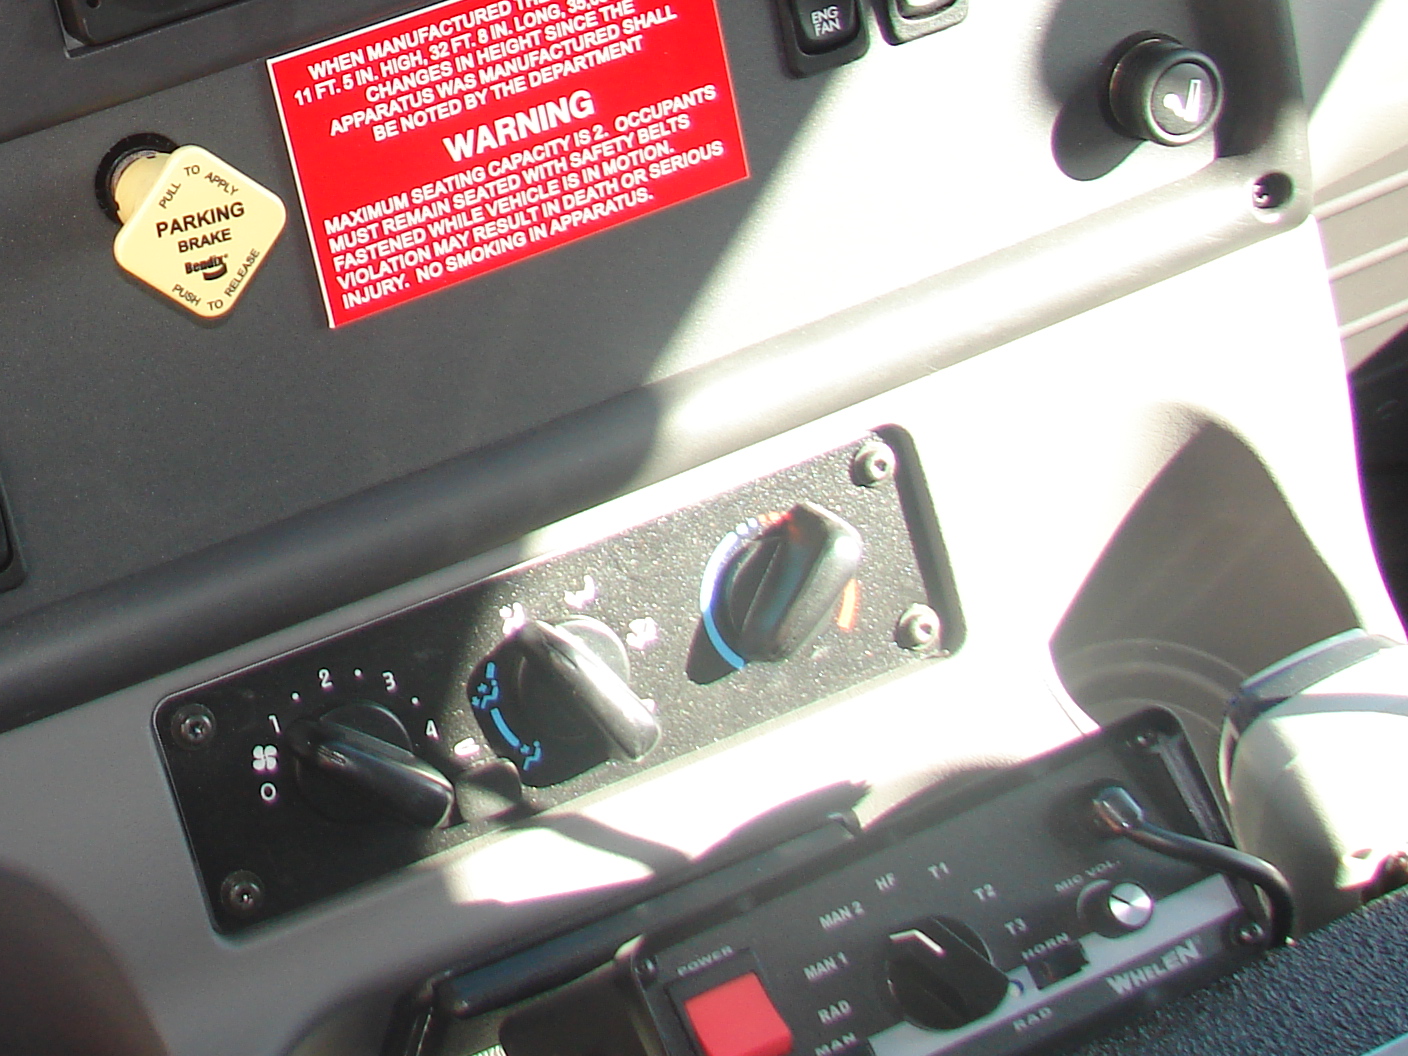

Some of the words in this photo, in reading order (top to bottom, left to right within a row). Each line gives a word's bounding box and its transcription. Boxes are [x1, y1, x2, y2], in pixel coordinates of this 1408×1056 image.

[811, 6, 839, 25] ENG
[814, 19, 841, 37] FAN
[294, 89, 313, 106] 11
[314, 79, 342, 100] FT.
[342, 74, 354, 90] 5
[355, 66, 379, 86] IN.
[380, 52, 429, 78] HIGH,
[429, 42, 450, 61] 32
[450, 32, 477, 54] FT.
[477, 28, 489, 44] 8
[489, 20, 513, 40] IN.
[514, 4, 566, 32] LONG,
[307, 48, 365, 80] WHEN
[367, 0, 512, 61] MANUFACTURED
[365, 62, 452, 102] CHANGES
[455, 53, 475, 72] IN
[476, 29, 542, 65] HEIGHT
[545, 11, 598, 41] SINCE
[330, 87, 435, 136] APPARATUS
[436, 73, 477, 99] WAS
[479, 24, 620, 85] MANUFACTURED
[622, 5, 678, 34] SHALL
[372, 122, 399, 142] BE
[401, 98, 462, 133] NOTED
[465, 88, 489, 110] BY
[491, 76, 528, 100] THE
[528, 35, 643, 89] DEPARTMENT
[442, 89, 595, 162] WARNING
[324, 192, 410, 235] MAXIMUM
[410, 165, 486, 204] SEATING
[487, 135, 571, 177] CAPACITY
[574, 129, 591, 147] IS
[592, 124, 610, 141] 2.
[614, 84, 716, 132] OCCUPANTS
[159, 181, 181, 210] PULL
[184, 164, 201, 177] TO
[204, 171, 239, 197] APPLY
[328, 222, 379, 254] MUST
[381, 197, 451, 236] REMAIN
[452, 174, 521, 209] SEATED
[522, 156, 568, 185] WITH
[570, 131, 635, 168] SAFETY
[637, 113, 691, 143] BELTS
[333, 228, 427, 272] FASTENED
[428, 206, 486, 238] WHILE
[485, 179, 561, 217] VEHICLE
[562, 173, 580, 191] IS
[582, 166, 601, 184] IN
[602, 140, 675, 178] MOTION.
[156, 201, 245, 238] PARKING
[336, 248, 432, 290] VIOLATION
[433, 230, 471, 257] MAY
[473, 206, 539, 243] RESULT
[542, 198, 561, 218] IN
[562, 178, 619, 211] DEATH
[621, 168, 648, 188] OR
[649, 140, 724, 179] SERIOUS
[178, 228, 232, 253] BRAKE
[342, 273, 411, 310] INJURY.
[415, 261, 443, 283] NO
[445, 232, 527, 273] SMOKING
[529, 222, 547, 243] IN
[549, 187, 655, 236] APPARATUS.
[172, 283, 202, 307] PUSH
[207, 299, 224, 311] TO
[224, 248, 260, 297] RELEASE
[268, 714, 281, 734] 1
[318, 668, 333, 689] 2
[382, 672, 397, 691] 3
[425, 720, 439, 739] 4
[928, 862, 950, 880] T1
[972, 884, 997, 902] T2
[819, 907, 854, 930] MAN
[851, 901, 865, 916] 2
[1004, 917, 1028, 936] T3
[677, 945, 734, 976] POWER
[803, 957, 839, 981] MAN
[1022, 932, 1070, 961] HORN
[1105, 936, 1203, 996] WHELEN
[817, 1000, 852, 1025] RAD
[1012, 1007, 1053, 1032] RAD
[814, 1032, 857, 1056] MAN
